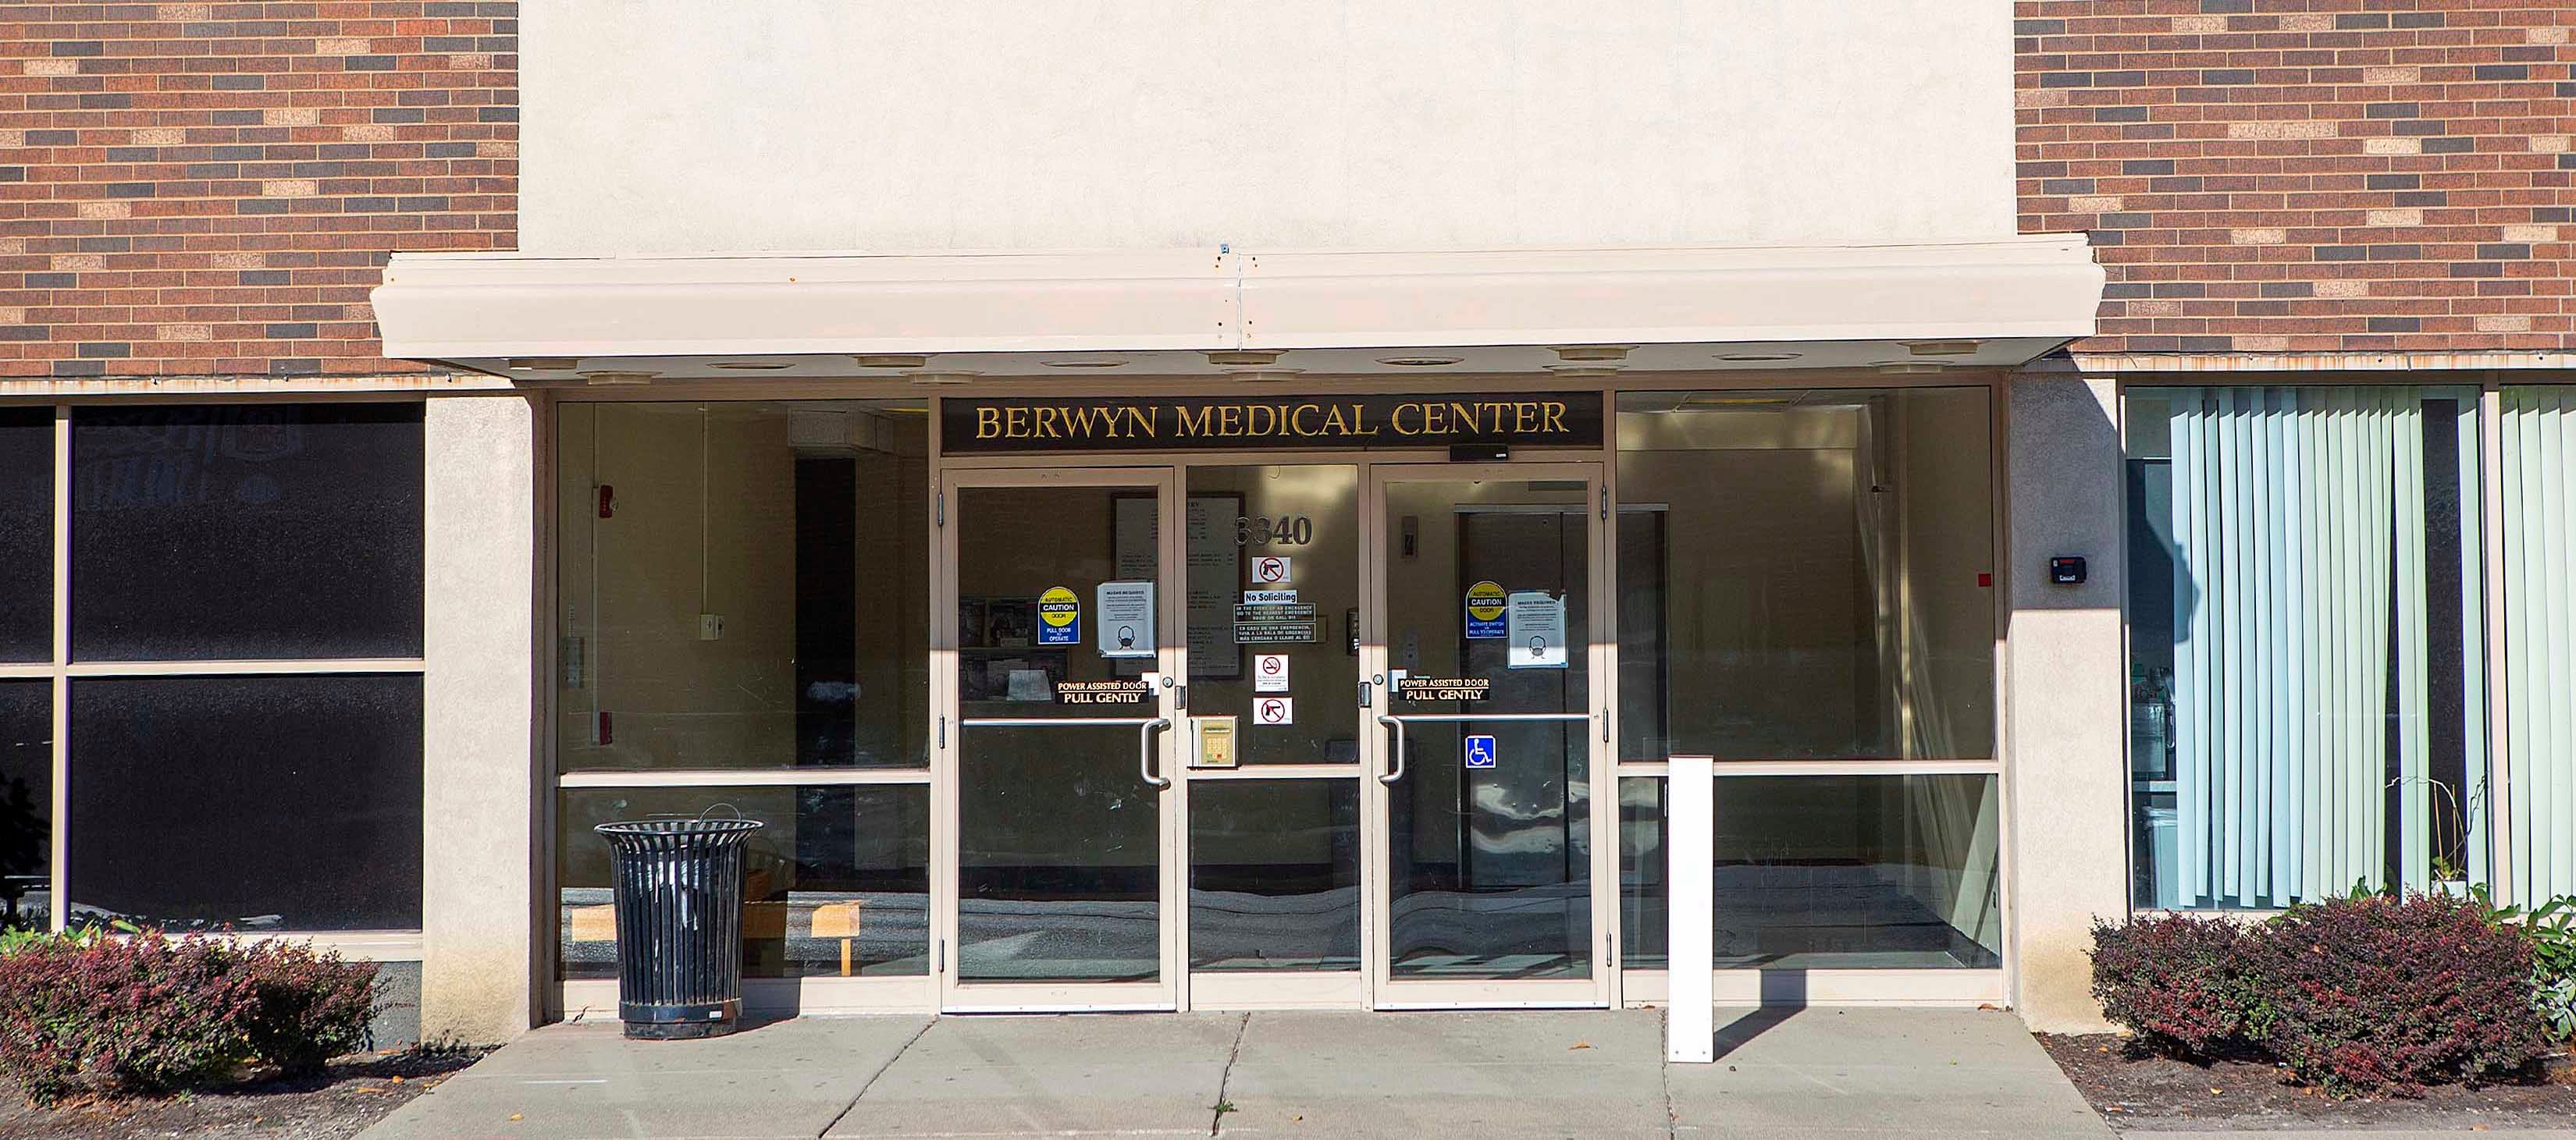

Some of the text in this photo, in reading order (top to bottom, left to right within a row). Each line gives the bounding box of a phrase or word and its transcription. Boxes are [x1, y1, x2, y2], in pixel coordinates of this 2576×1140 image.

[976, 402, 1571, 439] BERWYN MEDICAL CENTER
[1233, 516, 1312, 545] 3340
[1246, 592, 1296, 602] No Soliciting
[1123, 681, 1147, 690] DOOR
[1064, 693, 1140, 703] PULL GENTLY
[1406, 690, 1483, 700] PULL GENTLY
